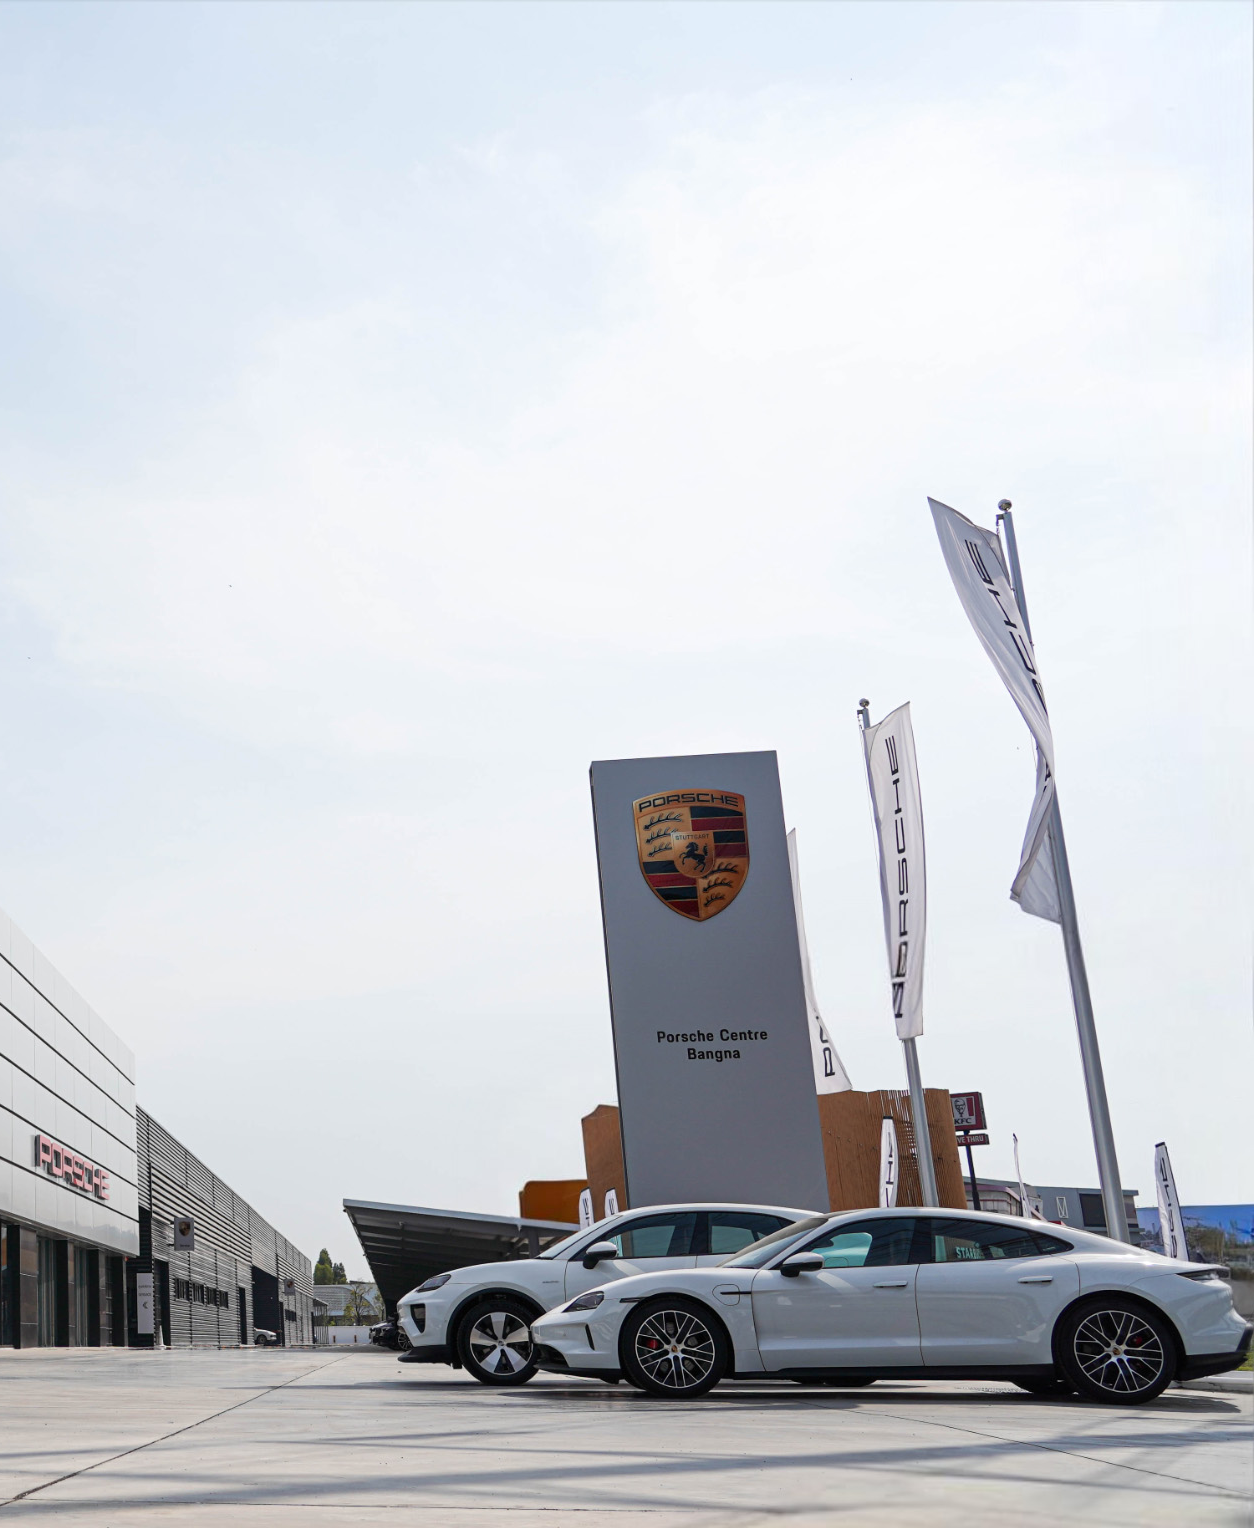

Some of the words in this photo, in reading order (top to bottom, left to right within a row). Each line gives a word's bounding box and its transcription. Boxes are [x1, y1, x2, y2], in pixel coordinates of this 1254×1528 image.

[638, 792, 739, 813] PORSCHE
[675, 833, 710, 841] STUTTGART
[656, 1029, 714, 1043] Porsche
[719, 1028, 768, 1042] Centre
[687, 1047, 741, 1063] Bangna
[954, 1117, 972, 1125] KFC
[966, 1135, 984, 1143] THRU
[34, 1134, 110, 1200] PORSCHE
